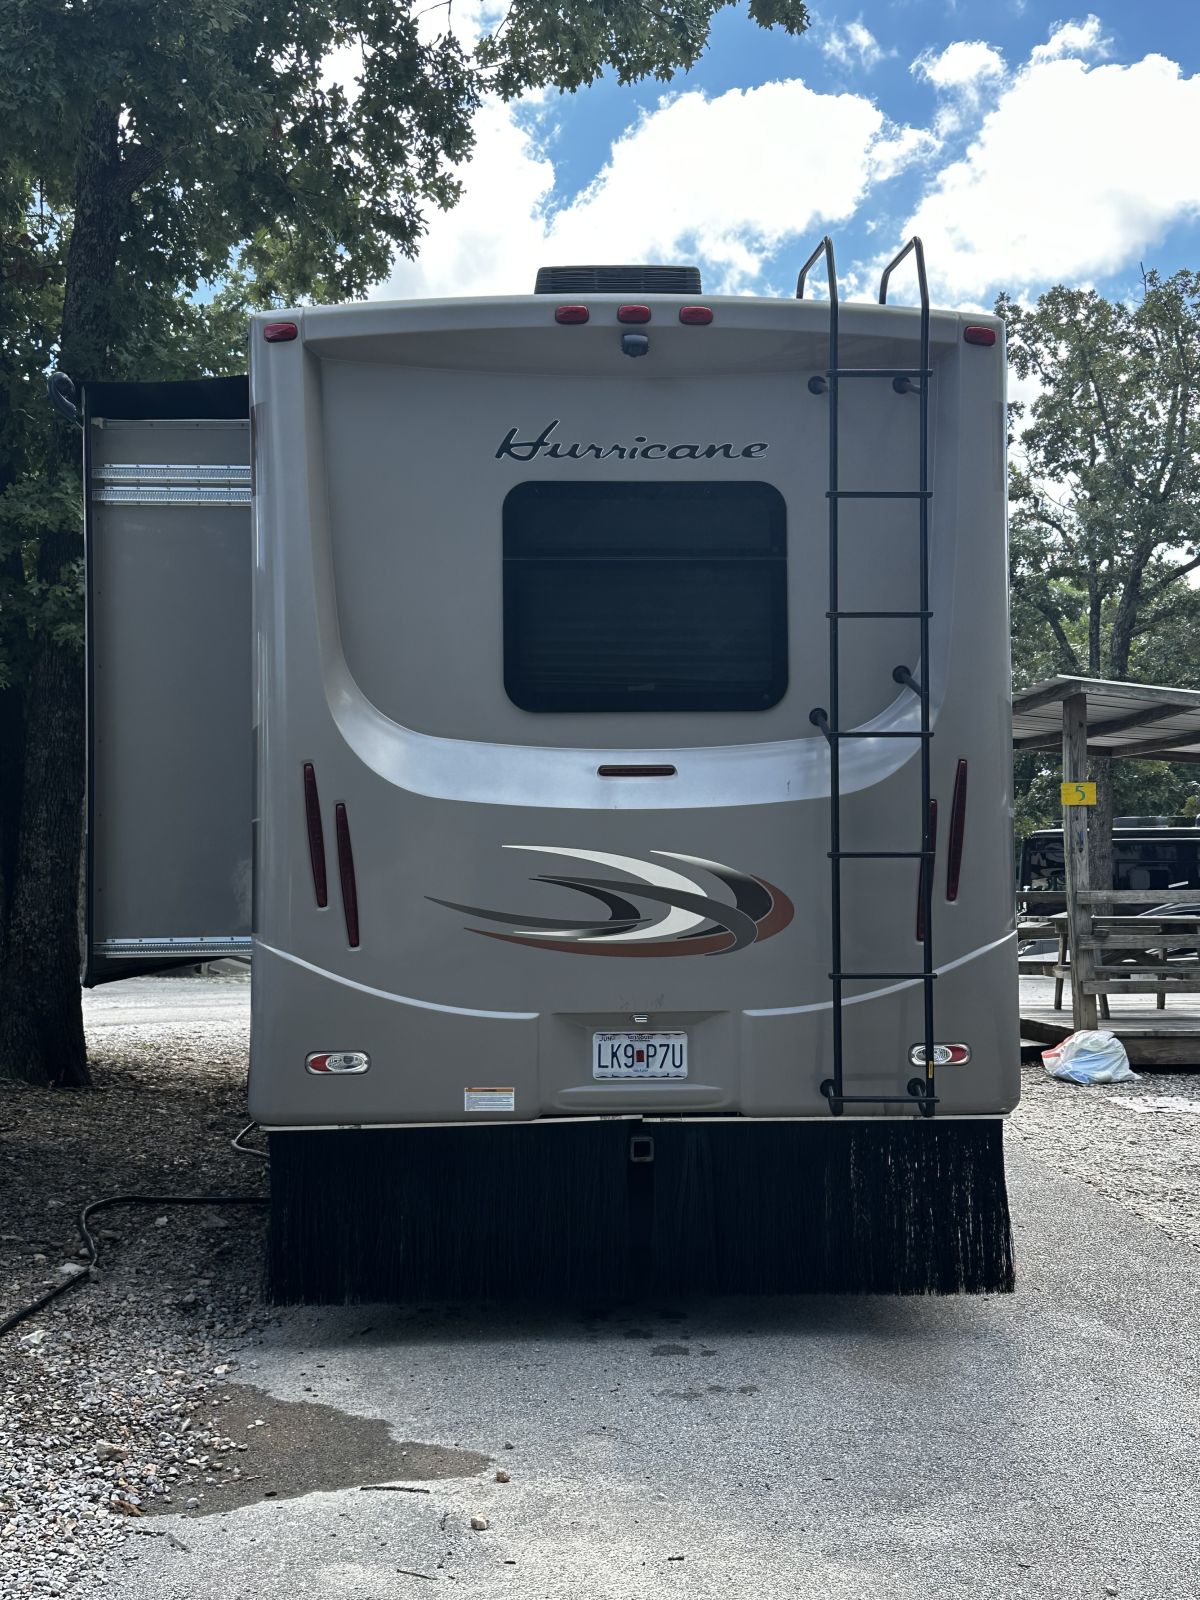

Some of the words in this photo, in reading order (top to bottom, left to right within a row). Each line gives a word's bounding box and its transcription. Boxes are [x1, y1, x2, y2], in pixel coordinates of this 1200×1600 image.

[495, 419, 769, 461] Hurricane
[1075, 785, 1086, 801] 5
[598, 1043, 635, 1069] LK9
[646, 1043, 683, 1069] P7U
